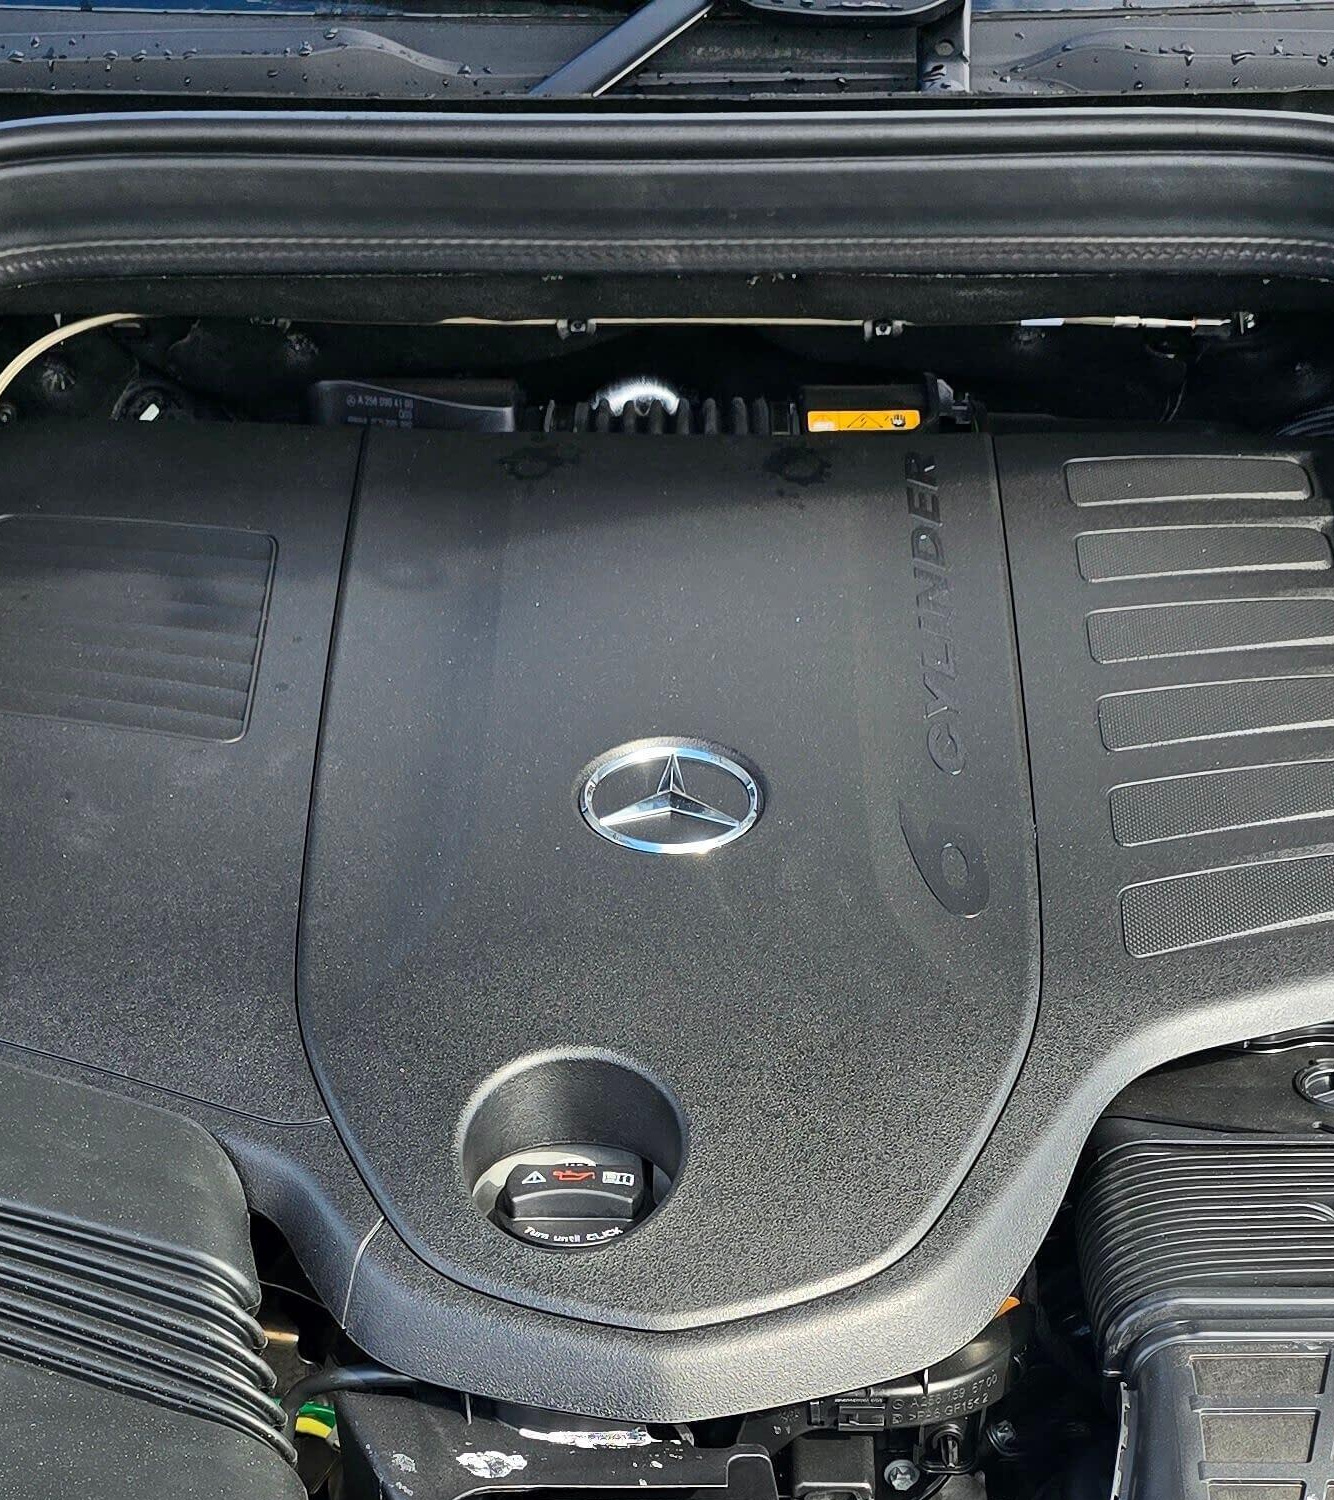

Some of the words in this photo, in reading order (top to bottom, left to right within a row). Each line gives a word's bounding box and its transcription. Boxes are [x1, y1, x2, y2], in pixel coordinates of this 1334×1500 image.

[905, 450, 967, 776] CYLINDER
[898, 796, 991, 918] 6
[524, 1226, 549, 1240] Turn
[553, 1234, 581, 1243] until
